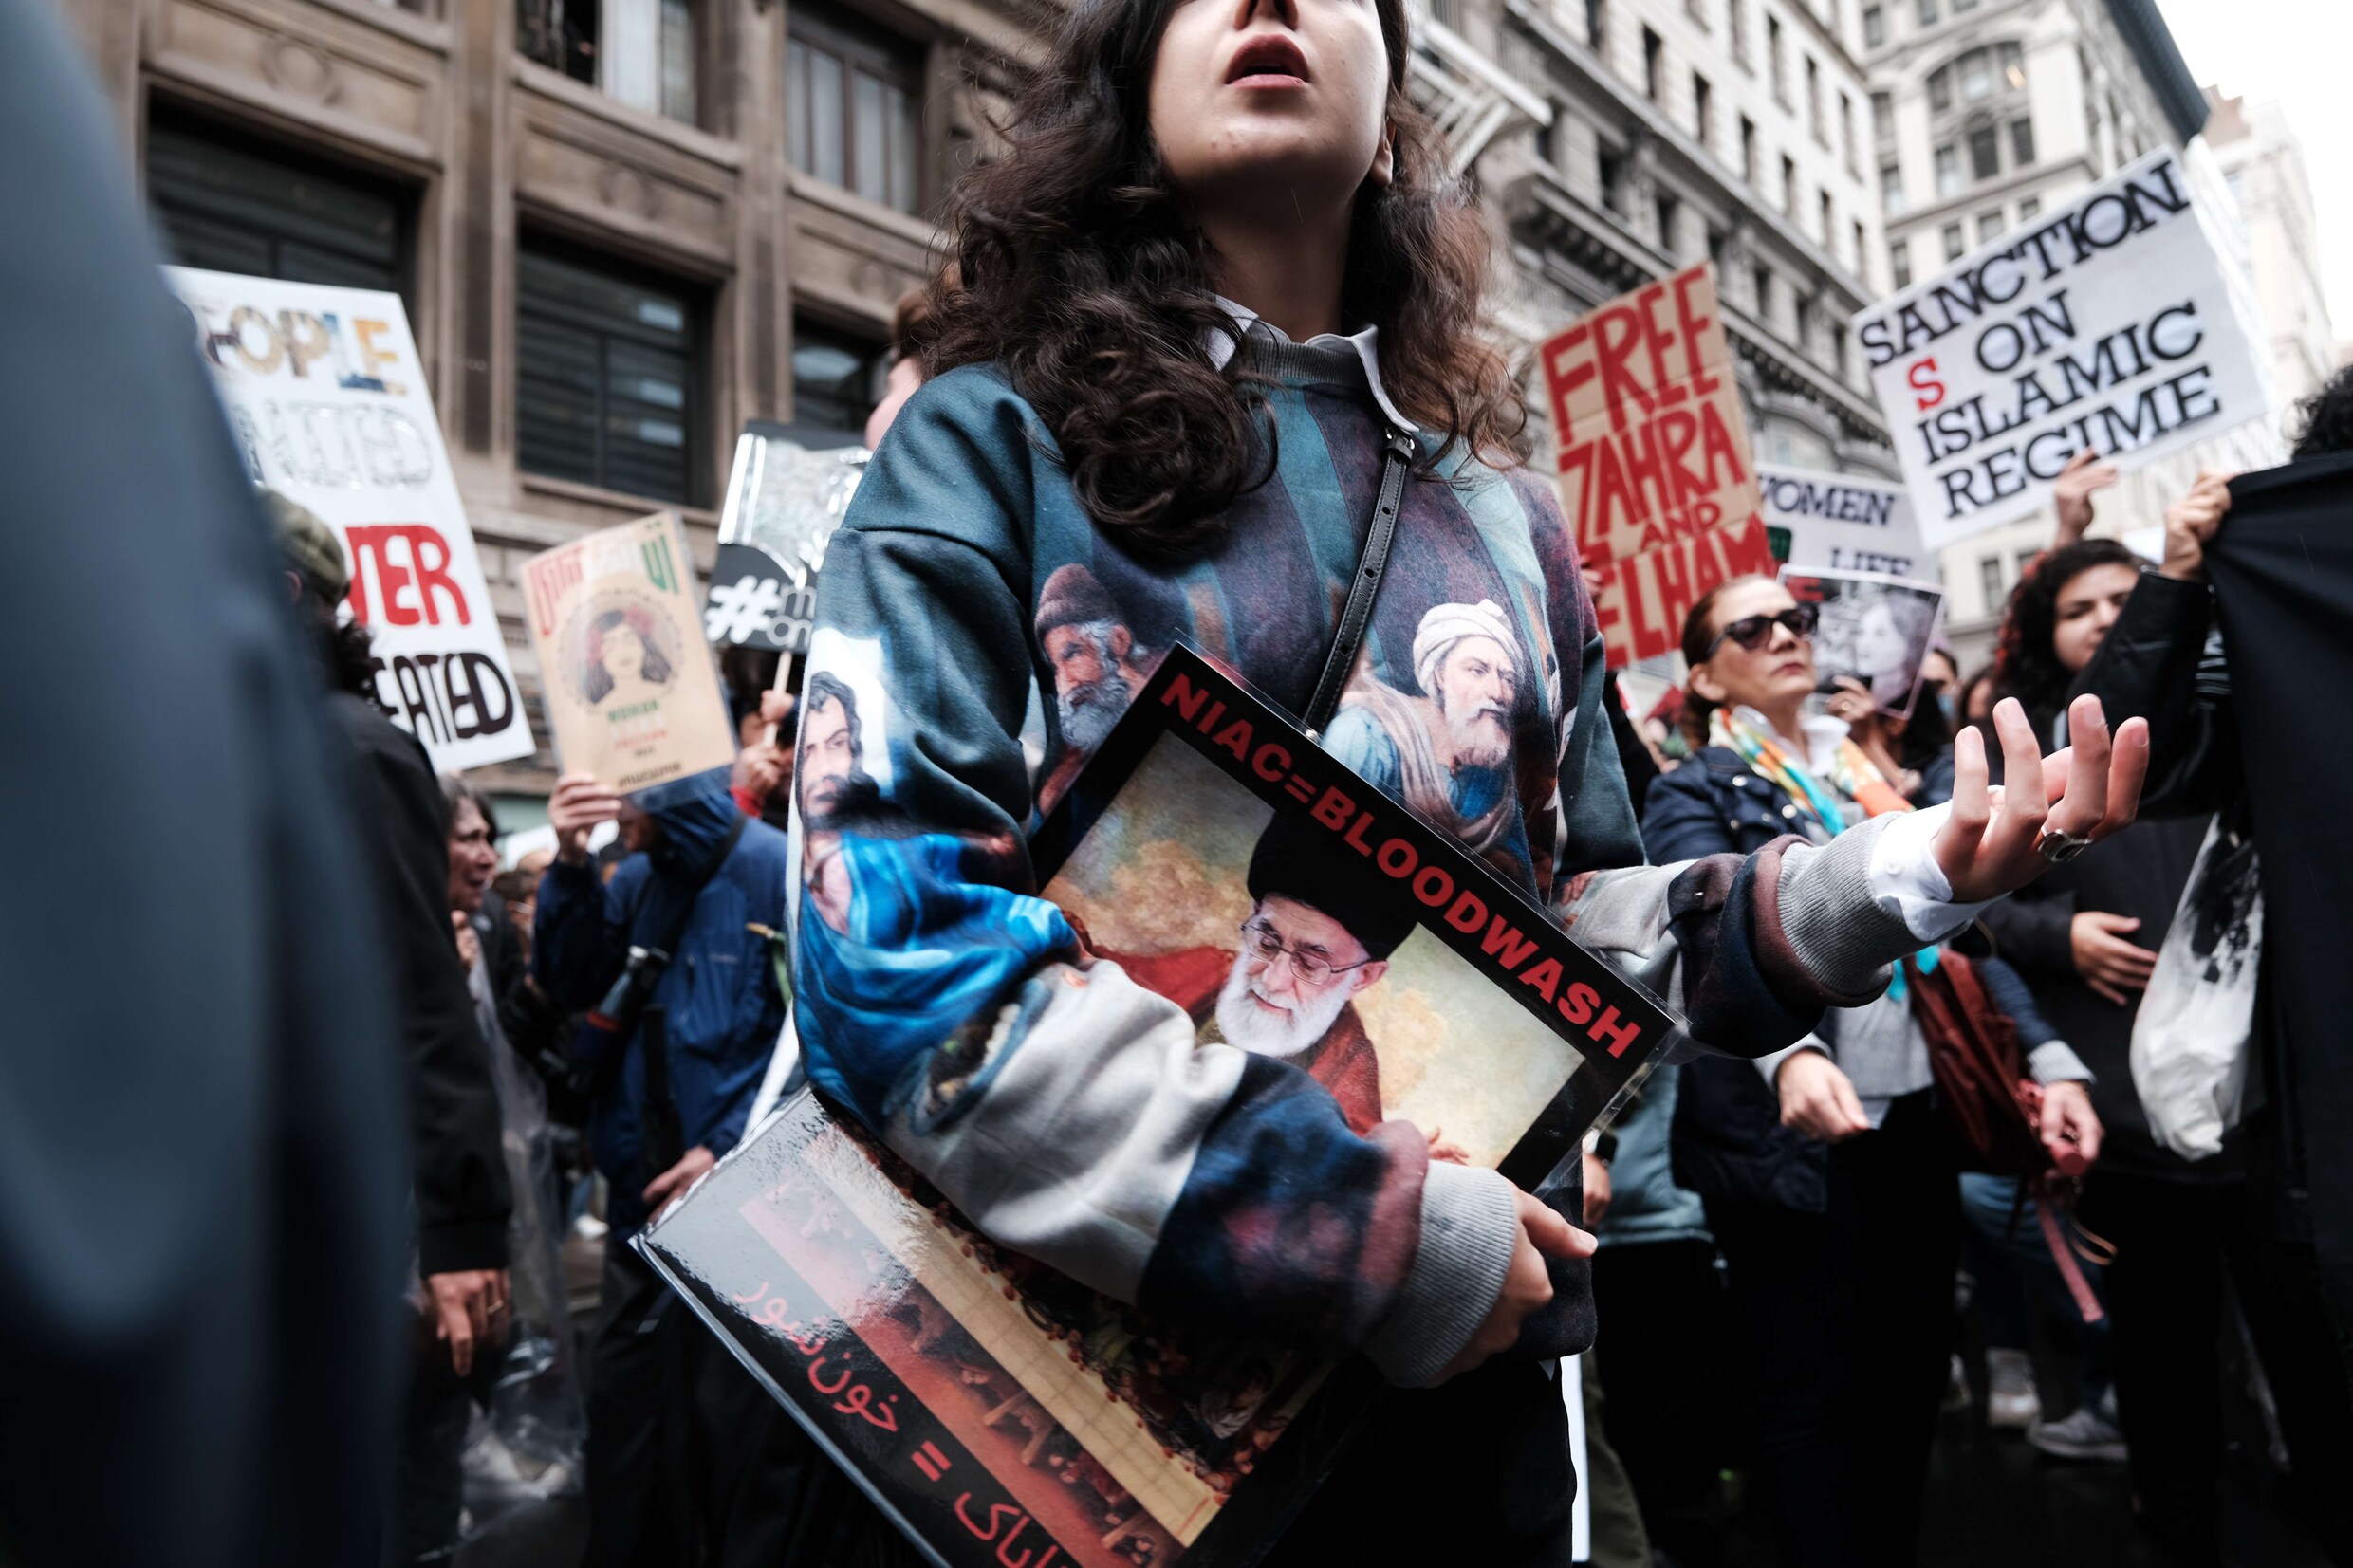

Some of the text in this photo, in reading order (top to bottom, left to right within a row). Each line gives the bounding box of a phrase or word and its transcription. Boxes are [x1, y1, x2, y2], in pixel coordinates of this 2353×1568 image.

[1860, 160, 2192, 368] SANCTION
[1541, 267, 1719, 447] FREE
[1908, 289, 2078, 411] S ON
[1917, 301, 2203, 465] ISLAMIC
[1559, 400, 1746, 569] ZAHRA
[1937, 365, 2221, 519] REGIME
[1640, 502, 1722, 553] AND
